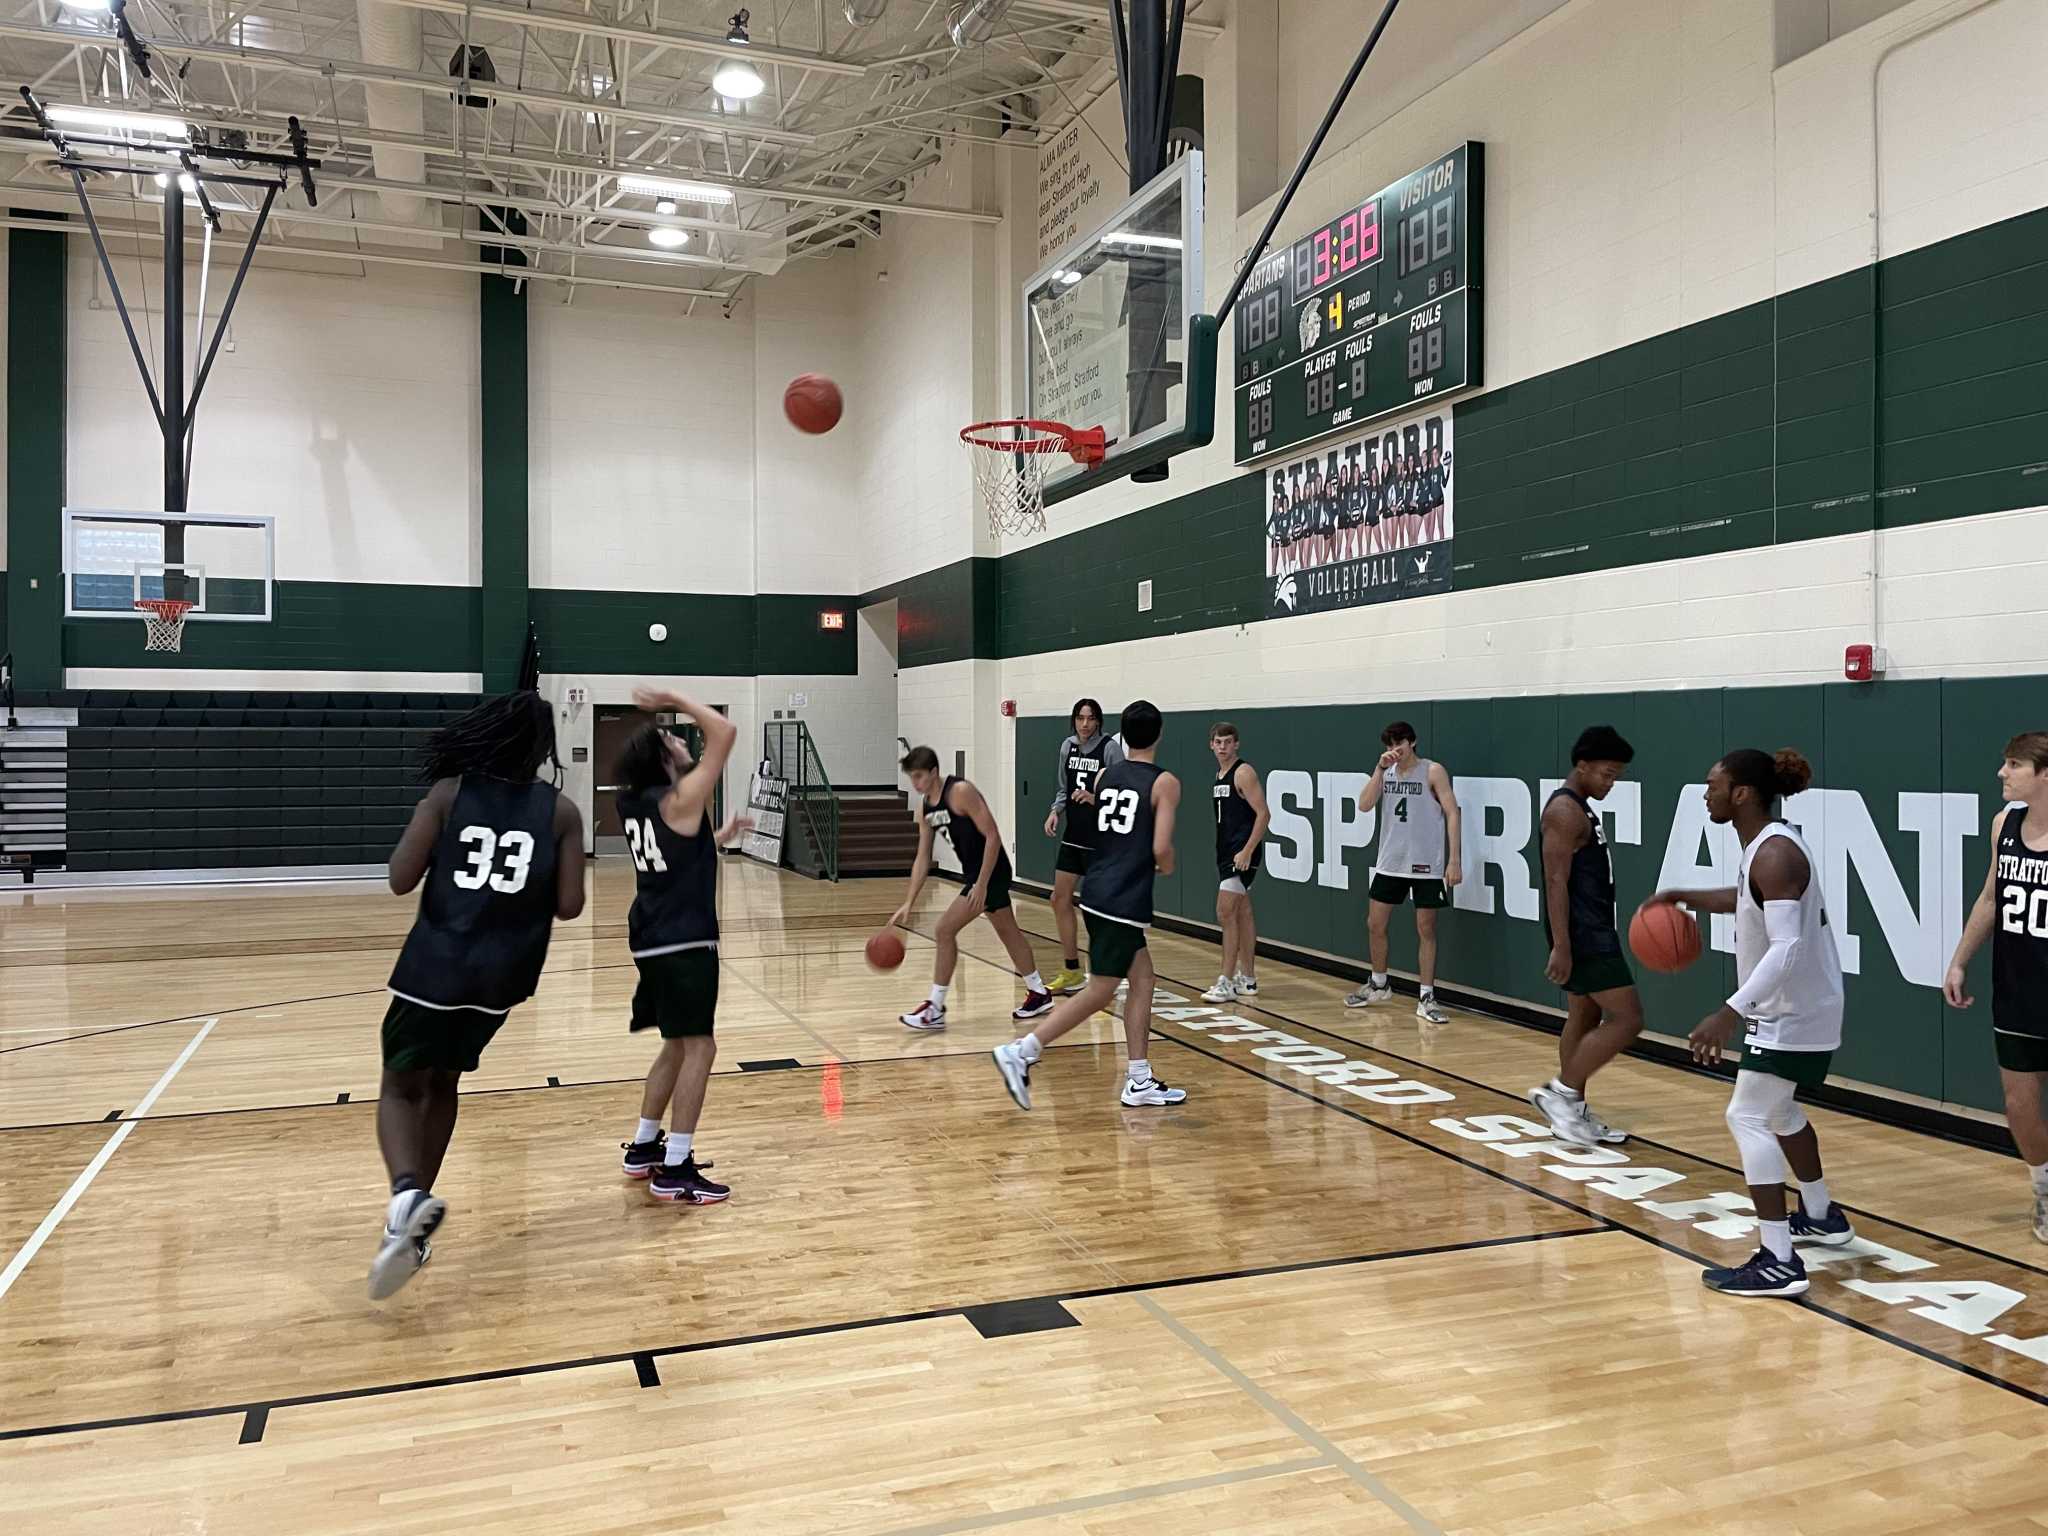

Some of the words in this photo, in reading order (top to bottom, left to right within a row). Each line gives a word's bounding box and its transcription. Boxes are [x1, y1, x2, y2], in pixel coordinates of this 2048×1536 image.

[1040, 149, 1056, 174] ALMA
[1057, 128, 1079, 157] MATER
[1050, 169, 1061, 187] sing
[1069, 152, 1080, 173] you
[1052, 175, 1076, 206] Stratford
[1077, 162, 1091, 184] High
[1400, 159, 1454, 212] VISITOR
[1050, 205, 1069, 233] pledge
[1080, 180, 1100, 206] loyalty
[1049, 232, 1065, 252] honor
[1066, 222, 1077, 243] you
[1313, 201, 1378, 287] 3:26
[1329, 291, 1342, 330] 4
[1347, 290, 1371, 312] PERIOD
[1409, 303, 1442, 334] FOULS
[1305, 349, 1337, 379] PLAYER
[1345, 334, 1373, 361] FOULS
[1249, 379, 1272, 401] FOULS
[1414, 377, 1434, 397] WON
[1332, 406, 1353, 425] GAME
[1253, 439, 1267, 454] WON
[1272, 415, 1444, 502] STRATFORD
[1308, 556, 1399, 597] VOLLEYBALL
[1337, 590, 1365, 602] 2021
[1068, 756, 1100, 772] STRATFORD
[1384, 780, 1423, 795] STRATFORD
[1098, 787, 1139, 834] 23
[1395, 797, 1408, 822] 4
[453, 825, 535, 894] 33
[624, 817, 668, 873] 24
[1264, 769, 2030, 988] SPRAN
[2002, 884, 2048, 939] 20
[1429, 1114, 2048, 1366] SPARTA
